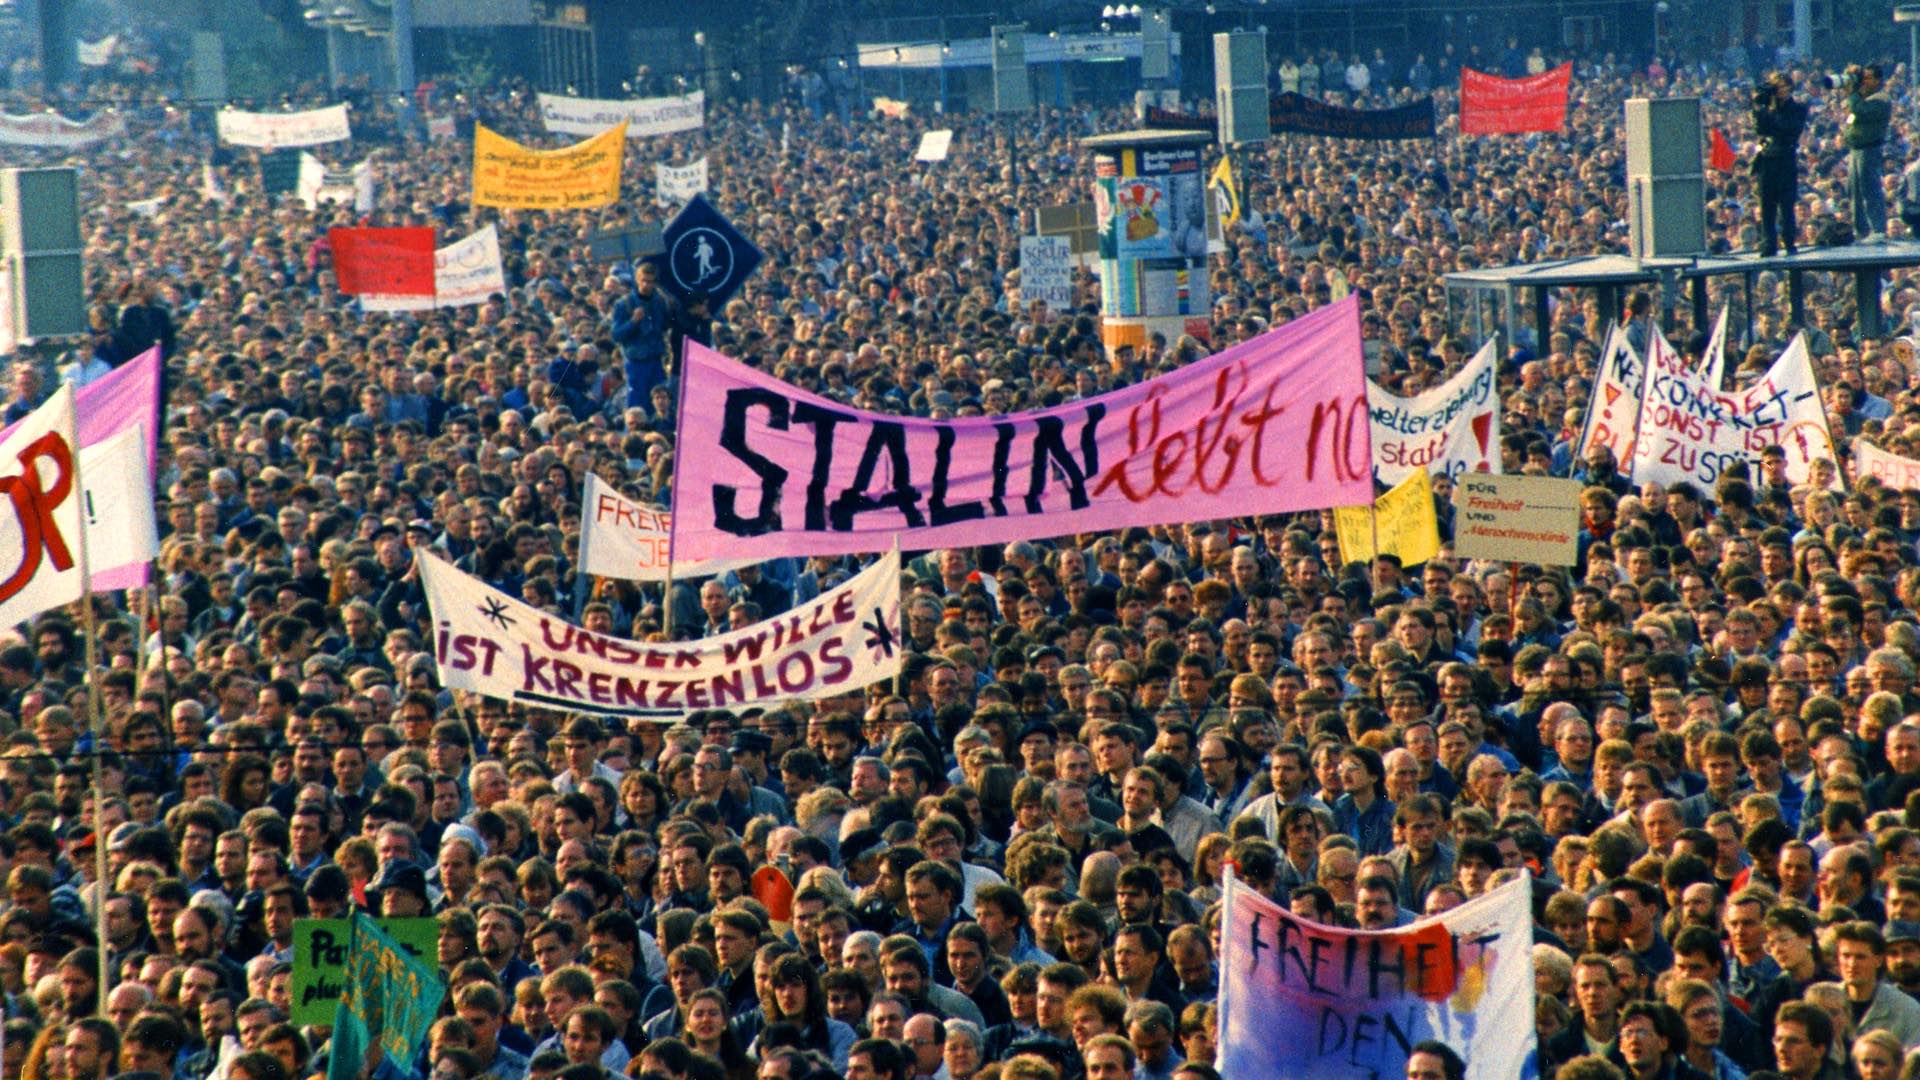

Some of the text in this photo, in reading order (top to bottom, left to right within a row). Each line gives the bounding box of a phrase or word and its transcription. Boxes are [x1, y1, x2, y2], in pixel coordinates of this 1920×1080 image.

[712, 387, 1106, 538] STALIN
[1092, 359, 1285, 503] lebt
[1660, 438, 1697, 472] ZU
[1744, 422, 1785, 451] IST
[1466, 481, 1497, 495] FÜR
[541, 589, 856, 669] UNSER WILLE
[521, 637, 854, 709] KRENZENLOS
[1250, 911, 1501, 999] FREIHEIT
